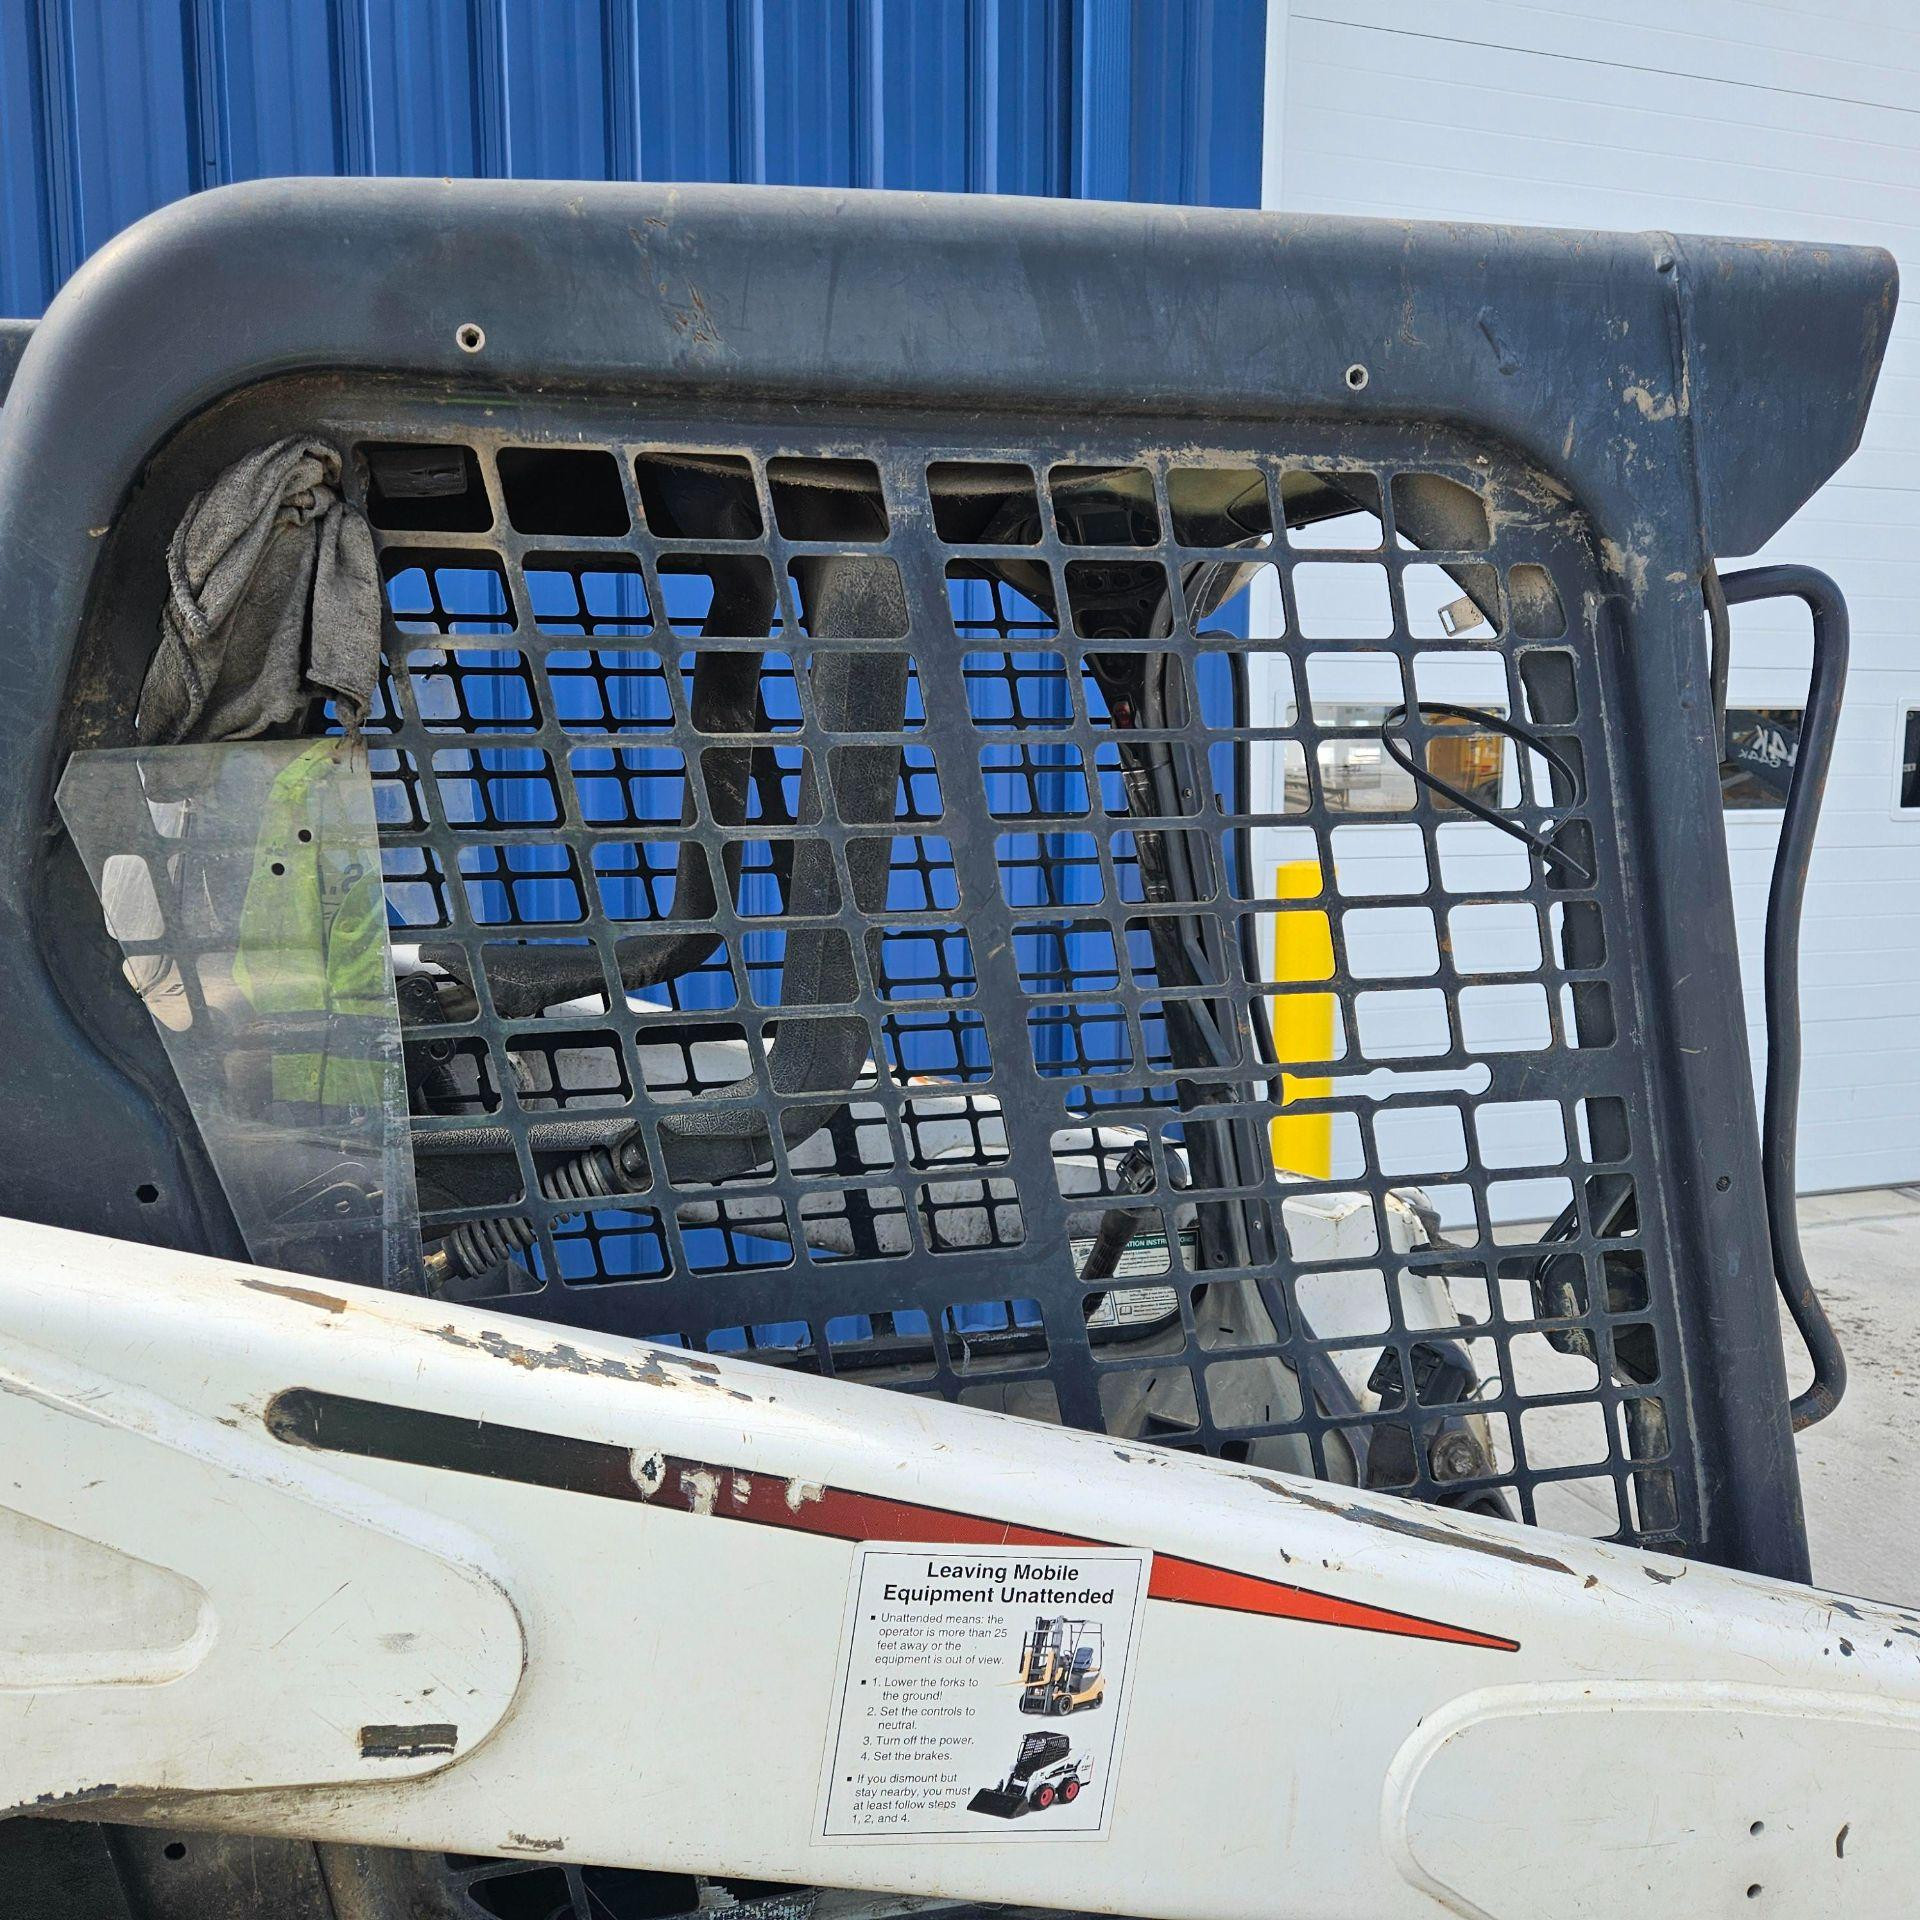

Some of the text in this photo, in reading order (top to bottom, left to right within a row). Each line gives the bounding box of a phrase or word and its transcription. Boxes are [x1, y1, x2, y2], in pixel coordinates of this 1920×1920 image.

[927, 1562, 1079, 1582] Leaving Mobile
[884, 1584, 1114, 1605] Equipment Unattended
[881, 1613, 1004, 1624] Unattended means: the
[879, 1627, 1007, 1640] operator is more than 25
[877, 1641, 961, 1653] feet away or the
[875, 1655, 1004, 1666] equipment is out of view.
[873, 1677, 979, 1687] 1. Lower the forks to
[883, 1691, 943, 1704] the ground!
[867, 1706, 975, 1716] 2. Set the controls to
[878, 1721, 917, 1730] neutral.
[863, 1736, 975, 1747] 3. Turn off the power.
[861, 1751, 952, 1761] 4. Set the brakes.
[857, 1773, 957, 1785] If you dismount but
[855, 1787, 971, 1799] stay nearby, you must
[853, 1800, 956, 1810] at least follow steps
[852, 1814, 910, 1825] 1, 2, and 4.
